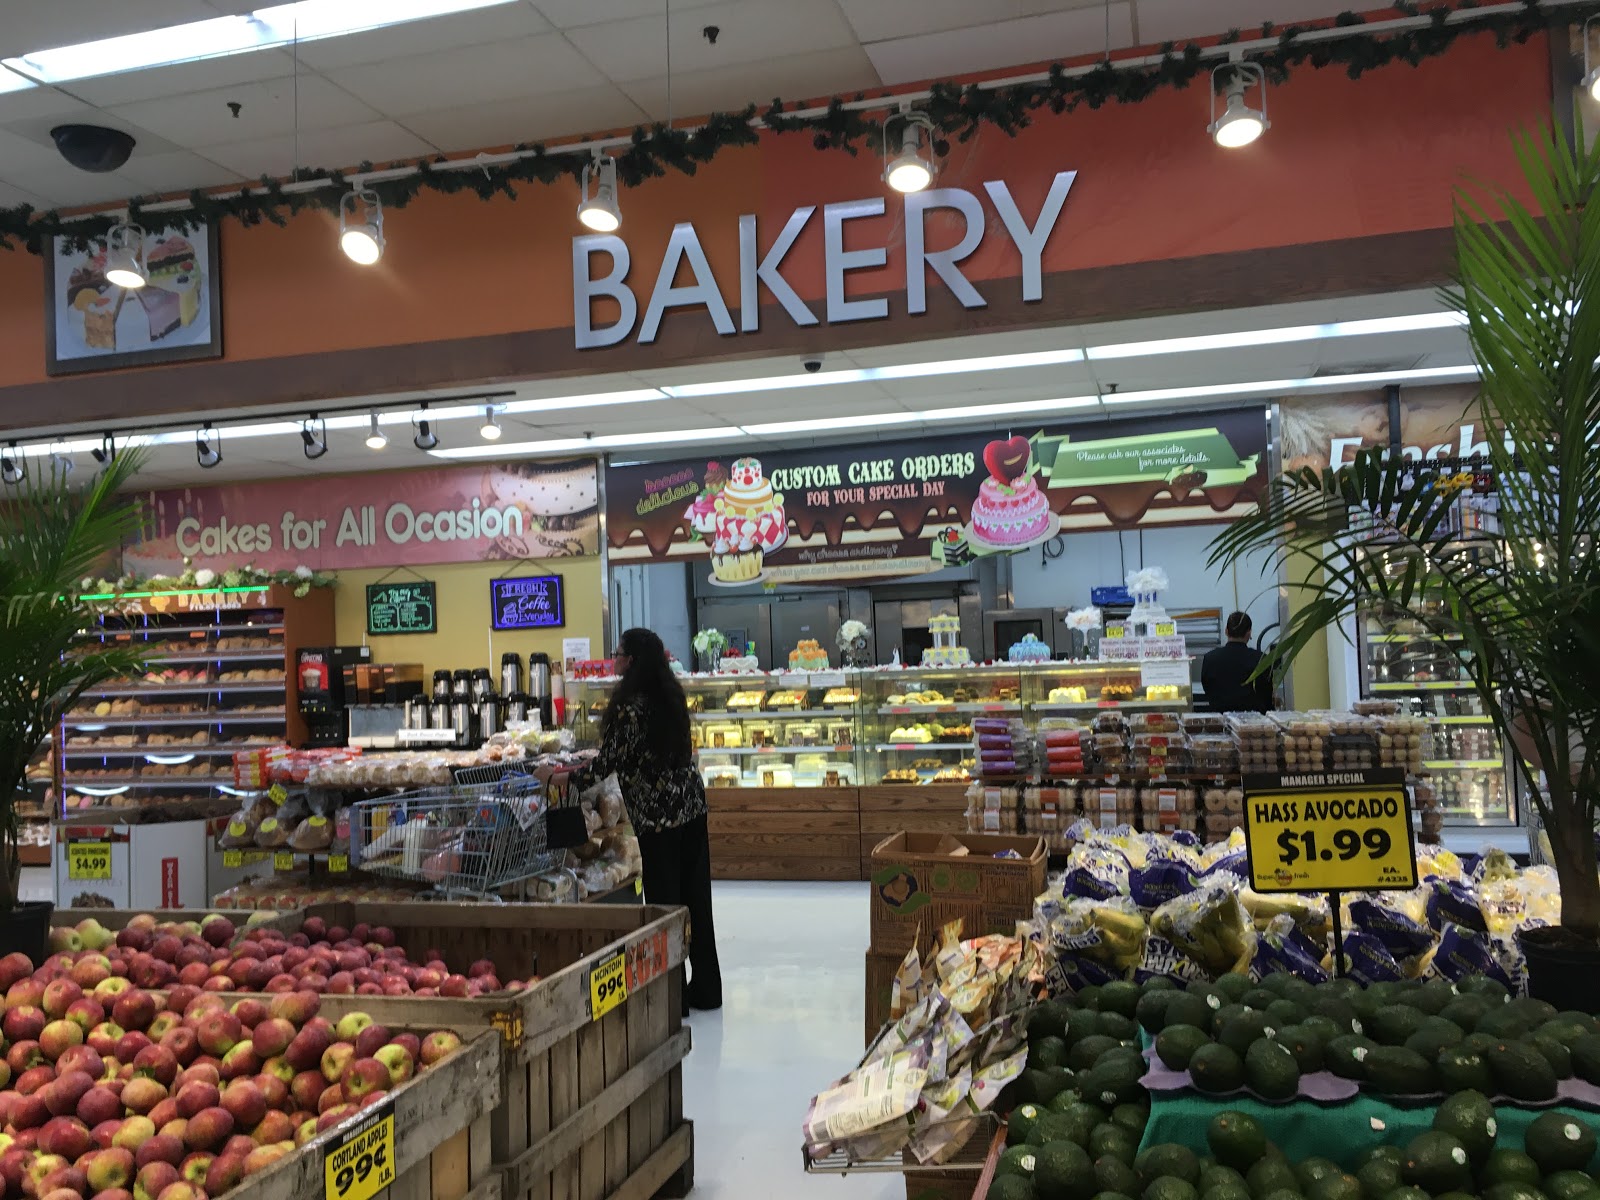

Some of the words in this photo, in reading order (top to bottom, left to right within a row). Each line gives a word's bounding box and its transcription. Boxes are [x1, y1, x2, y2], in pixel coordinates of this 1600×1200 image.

[572, 170, 1078, 349] BAKERY
[1076, 451, 1107, 462] Please
[1107, 448, 1124, 459] ask
[1124, 450, 1141, 458] our
[1141, 444, 1186, 457] associates
[1138, 457, 1155, 472] for
[1155, 456, 1179, 466] more
[770, 464, 842, 492] CUSTOM
[848, 459, 895, 485] CAKE
[901, 451, 975, 482] ORDERS
[636, 481, 699, 516] delicious
[806, 490, 830, 507] FOR
[834, 486, 865, 504] YOUR
[870, 483, 919, 501] SPECIAL
[922, 481, 946, 497] DAY
[176, 515, 272, 557] Cakes
[280, 511, 327, 551] for
[335, 506, 376, 548] All
[384, 496, 523, 545] Ocasion
[798, 547, 817, 564] why
[817, 547, 849, 559] choose
[849, 543, 898, 561] ordinary?
[177, 590, 250, 608] BAKERY
[518, 595, 551, 611] Coffee
[1280, 774, 1326, 787] MANAGER
[1326, 772, 1365, 785] SPECIAL
[1254, 802, 1299, 823] HASS
[1304, 797, 1398, 821] AVOCADO
[1276, 828, 1392, 866] $1.99
[76, 857, 107, 871] $4.99
[1382, 866, 1400, 874] EA.
[597, 971, 623, 1003] 99¢
[332, 1136, 366, 1173] CORTLAND
[366, 1121, 388, 1150] APPLES
[335, 1142, 387, 1198] 99¢
[378, 1166, 392, 1187] /LB.
